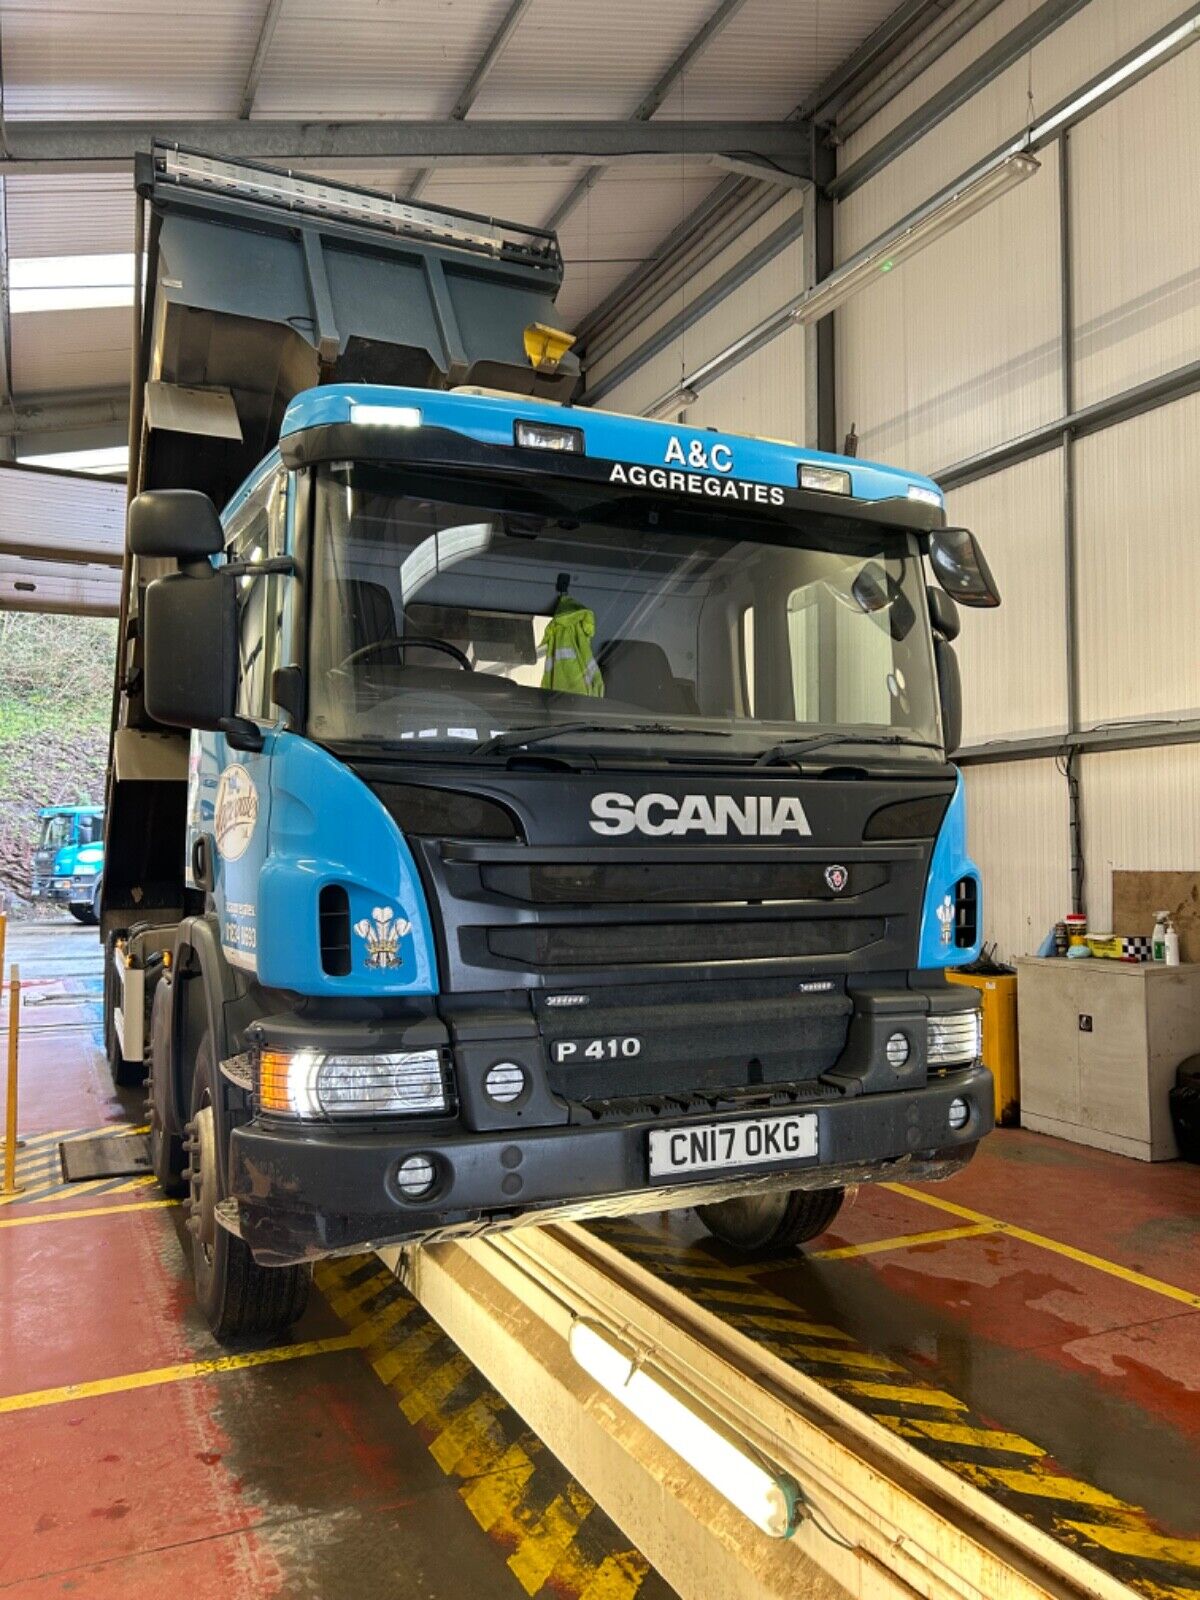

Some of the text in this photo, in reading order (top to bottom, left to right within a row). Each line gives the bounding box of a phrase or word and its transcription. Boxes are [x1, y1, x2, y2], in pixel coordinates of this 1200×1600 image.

[664, 435, 733, 473] A&C
[609, 463, 785, 506] AGGREGATES
[588, 792, 813, 836] SCANIA
[557, 1037, 641, 1062] P 410
[670, 1121, 800, 1166] CN17 OKG
